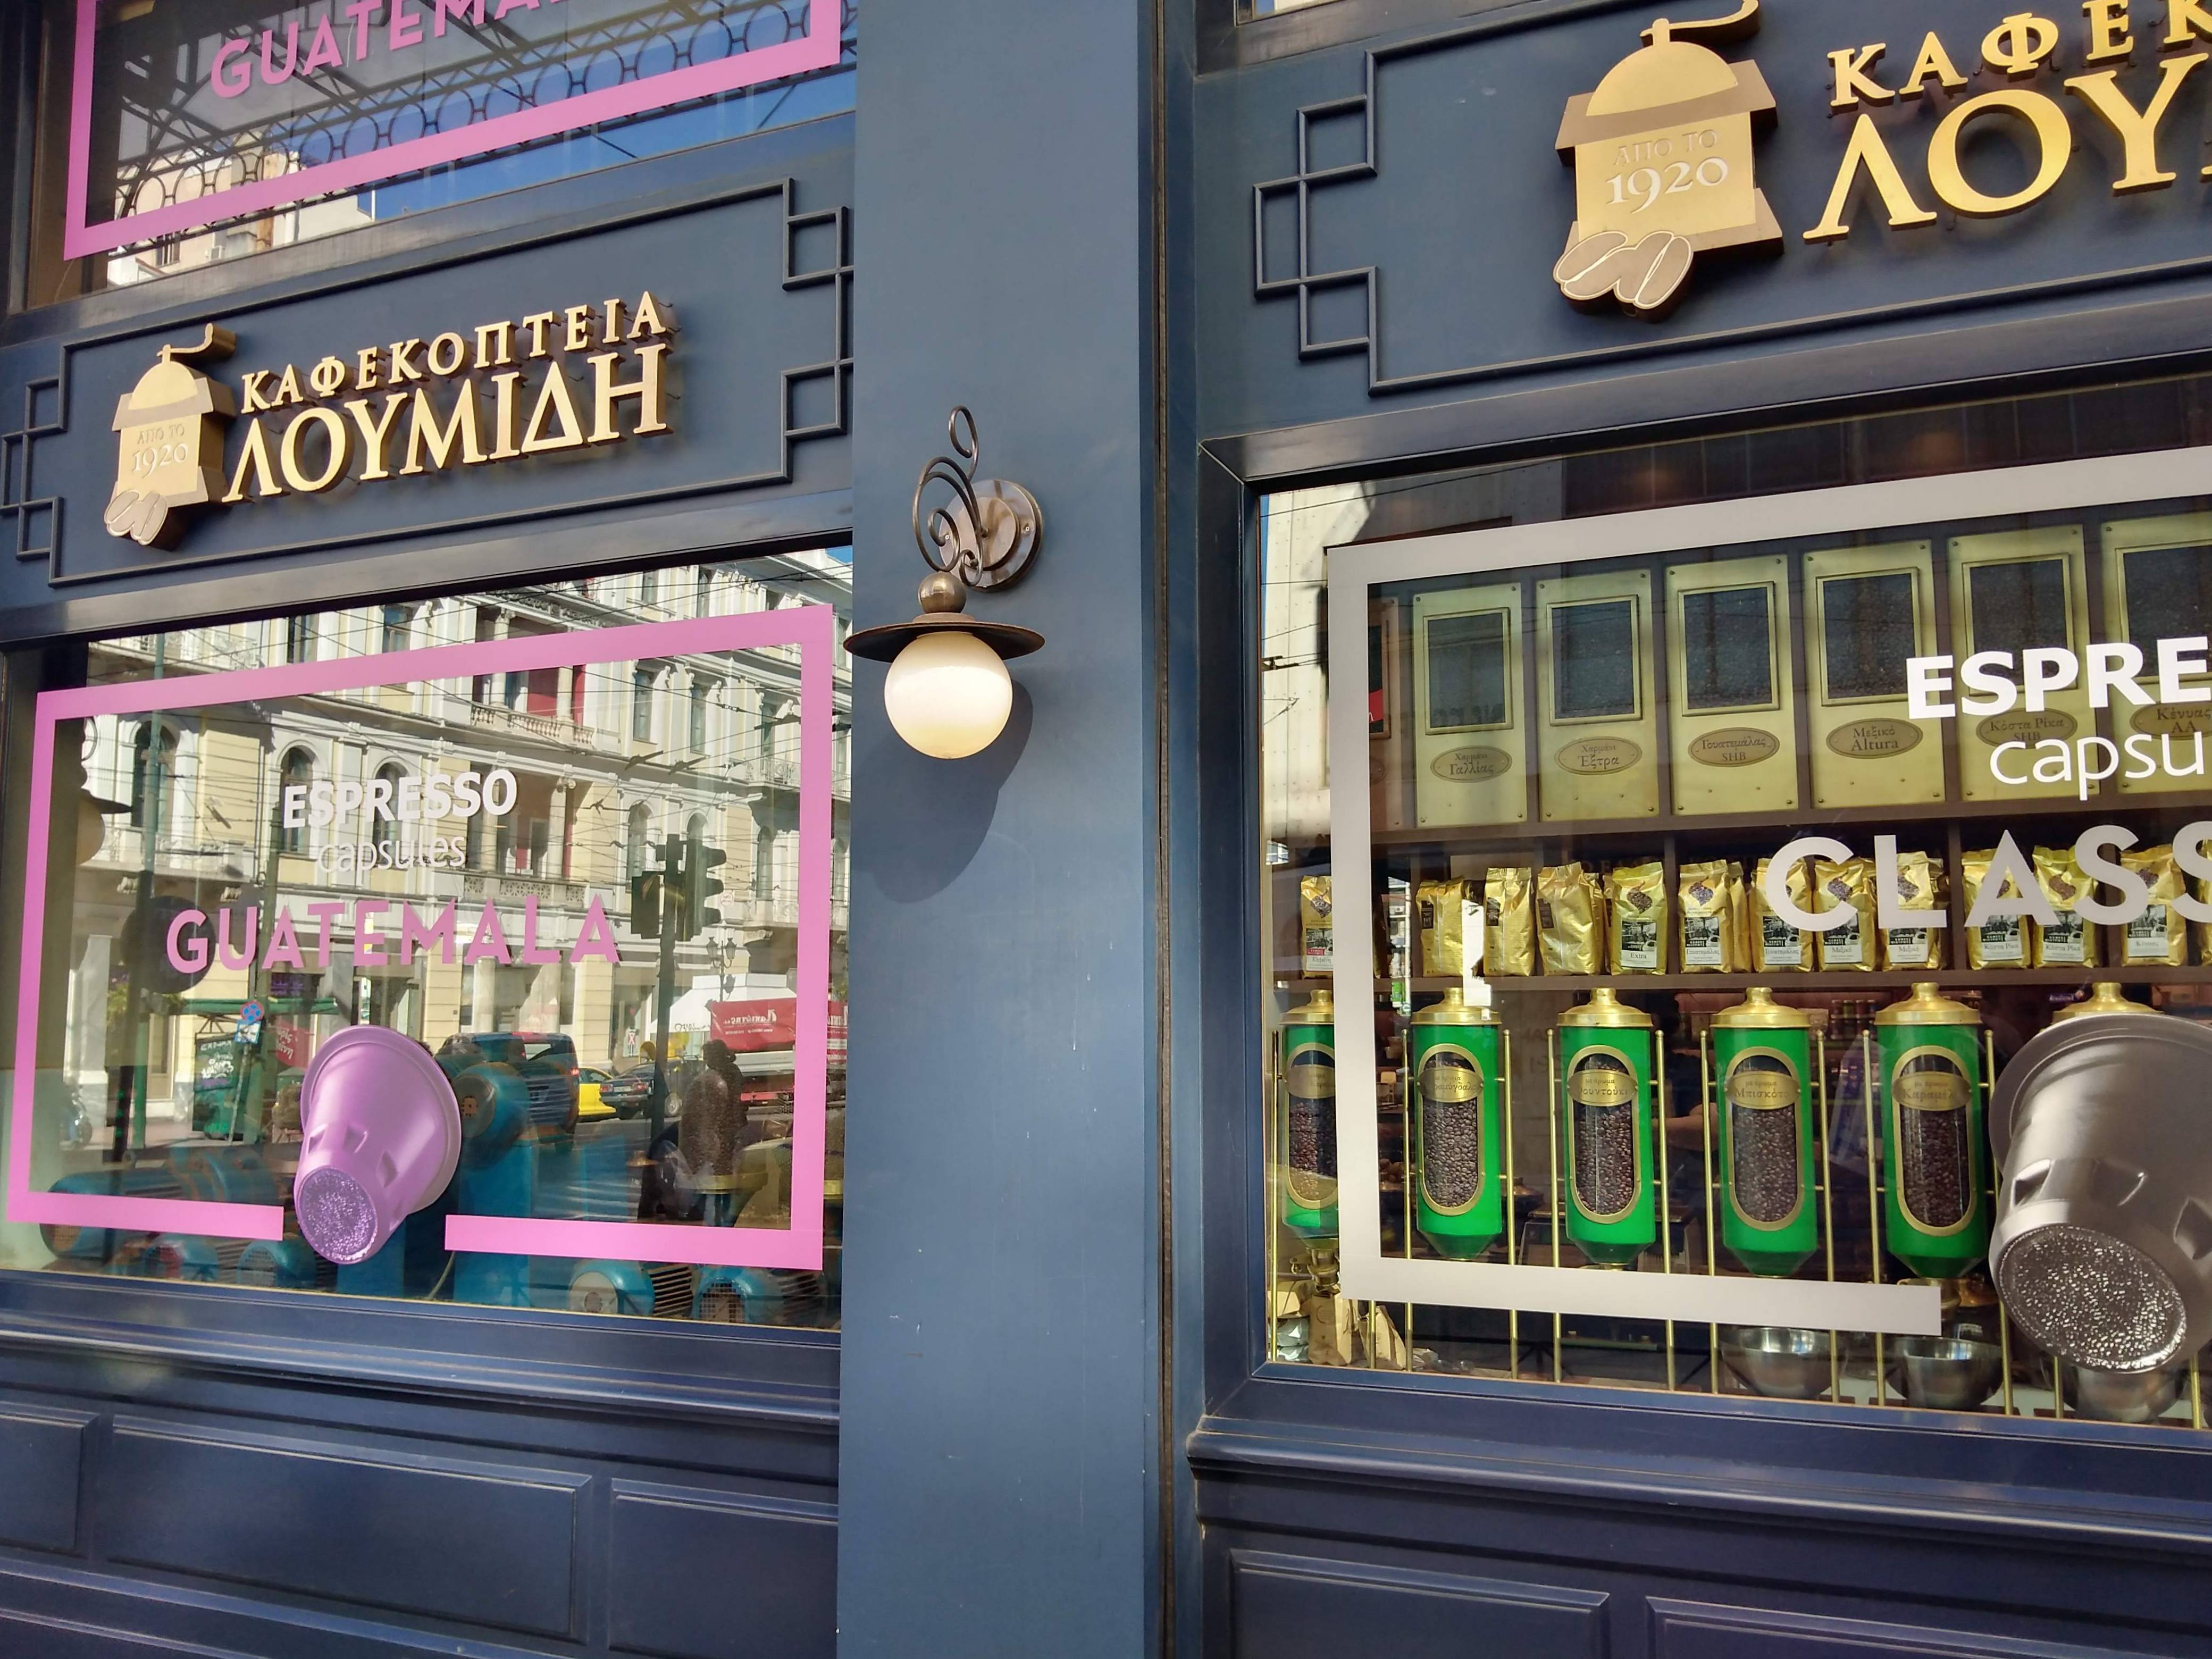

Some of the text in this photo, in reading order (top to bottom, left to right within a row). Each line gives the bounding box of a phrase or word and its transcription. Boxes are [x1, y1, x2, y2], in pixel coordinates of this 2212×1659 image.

[211, 0, 568, 98] GUATEM
[1613, 129, 1717, 166] ΑΠΟ ΤΟ
[1803, 52, 2212, 239] ΛΟΥ
[1605, 156, 1729, 215] 1920
[241, 290, 668, 415] ΚΑΦΕΚΟΠΤΕΙΑ
[221, 342, 672, 503] ΛΟΥΜΙΔΗ
[131, 442, 188, 479] 1920
[1906, 636, 2212, 719] ESPRE
[1722, 751, 1747, 762] SHB
[1851, 738, 1899, 751] Altura
[1990, 731, 2205, 801] capsu
[283, 769, 518, 830] ESPRESSO
[317, 826, 467, 886] capsules
[1765, 820, 2212, 932] CLASS
[166, 894, 619, 974] GUATEMALA
